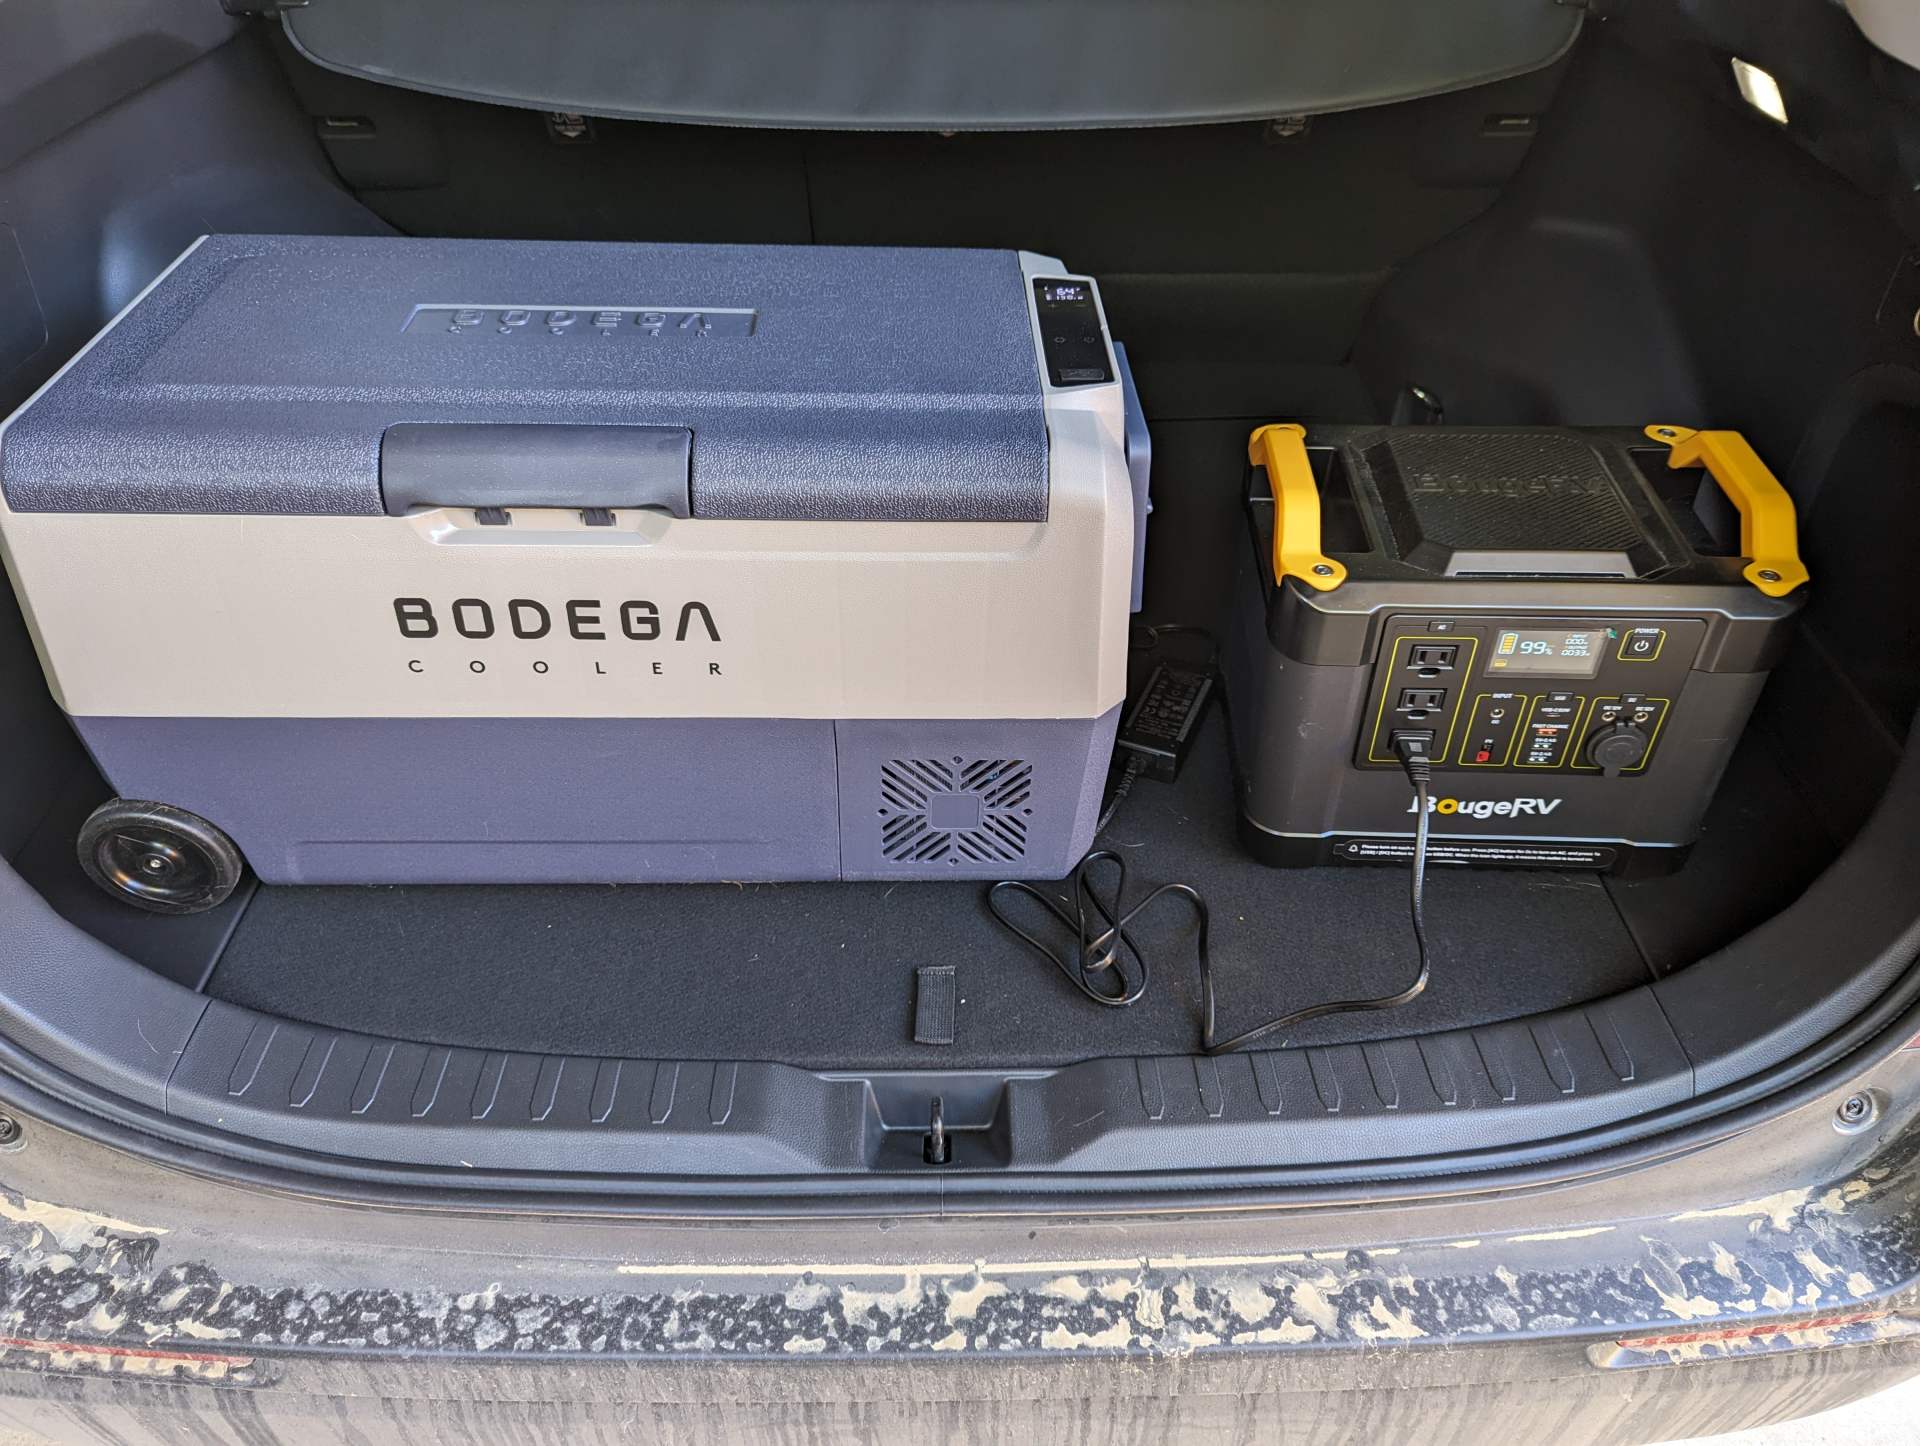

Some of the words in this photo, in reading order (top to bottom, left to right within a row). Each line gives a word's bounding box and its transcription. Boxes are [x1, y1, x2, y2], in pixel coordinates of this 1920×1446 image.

[453, 308, 711, 327] BODEGA
[393, 597, 722, 642] BODEGA
[408, 659, 722, 676] COOLER
[1406, 796, 1562, 819] BougeRV
